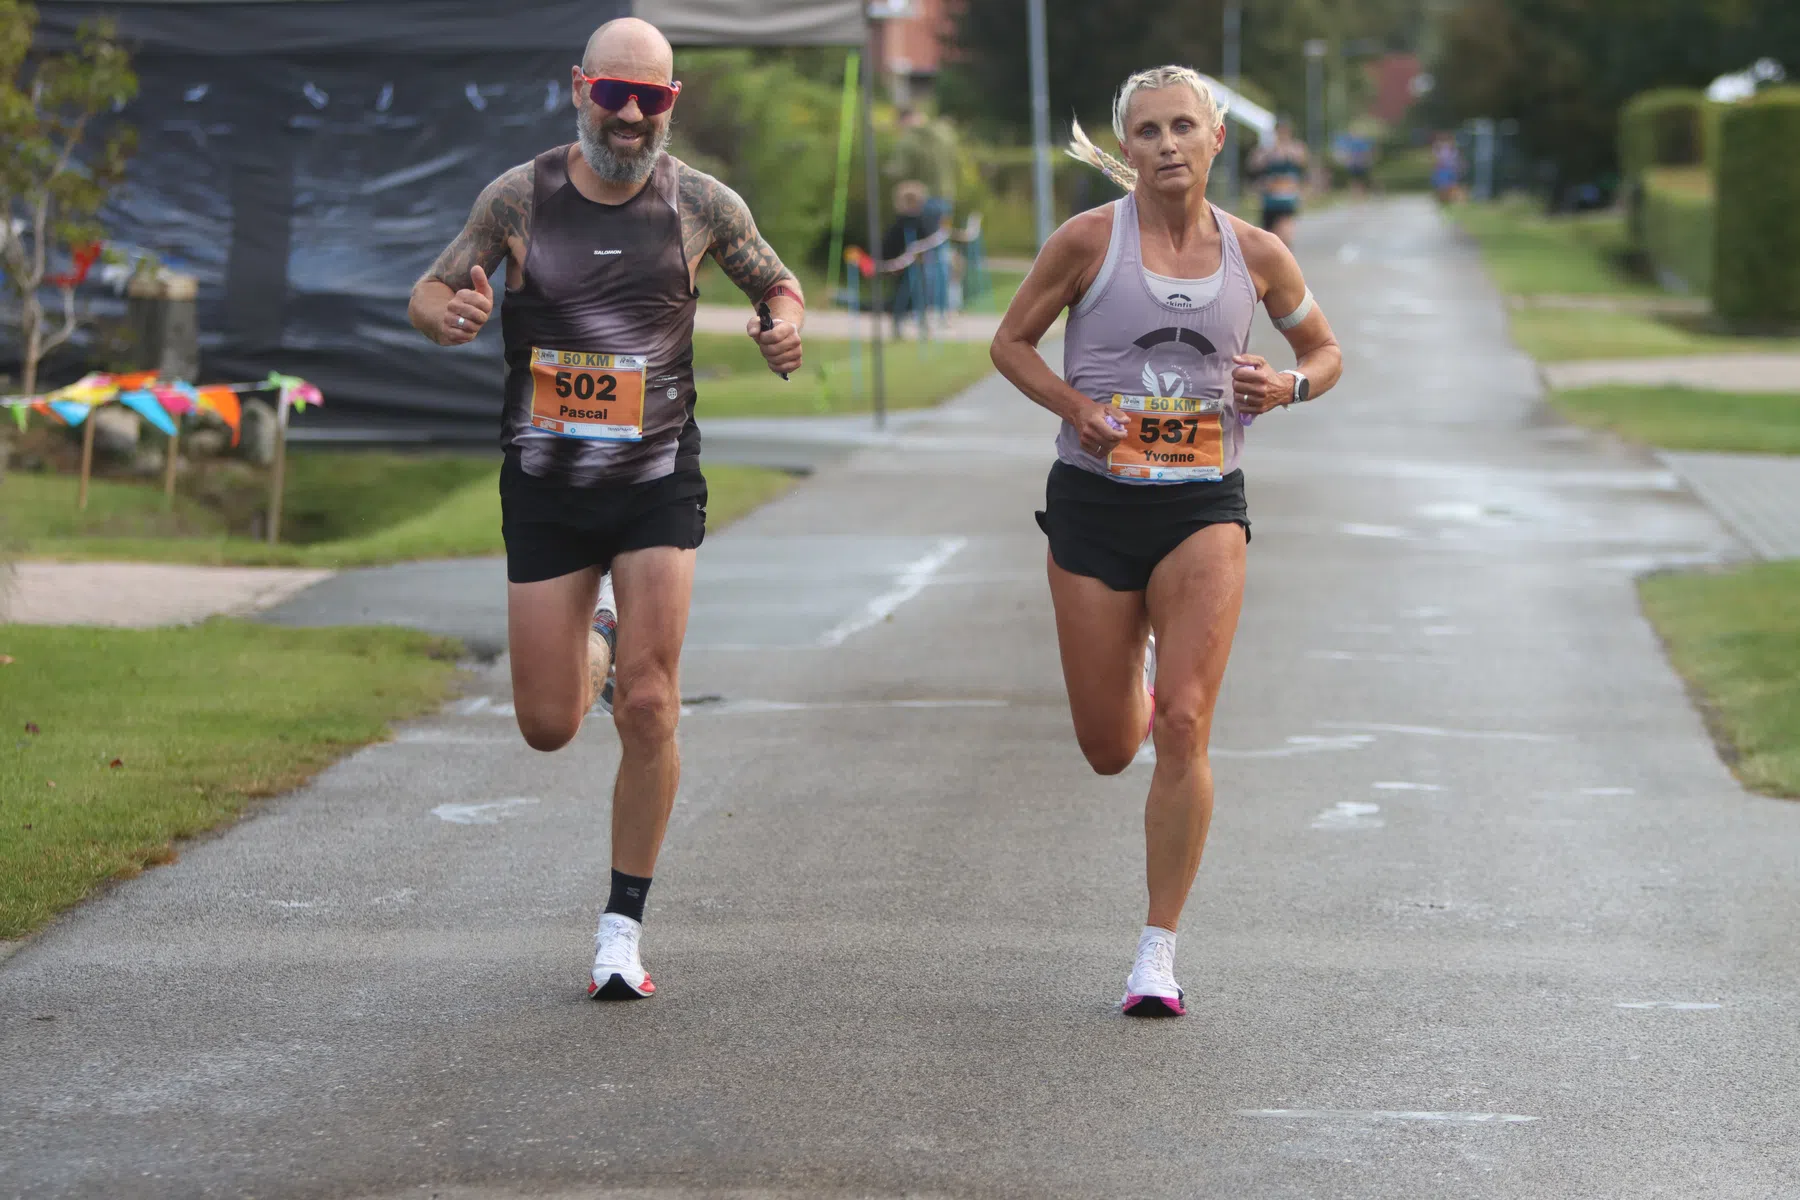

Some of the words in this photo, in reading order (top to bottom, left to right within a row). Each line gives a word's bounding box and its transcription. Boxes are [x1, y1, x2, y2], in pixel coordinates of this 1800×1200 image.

[563, 353, 581, 365] 50
[586, 355, 610, 367] KM
[556, 371, 617, 401] 502
[1150, 398, 1169, 411] 50
[1174, 400, 1197, 411] KM
[560, 405, 608, 420] Pascal
[1139, 417, 1199, 444] 537
[1143, 450, 1195, 463] Yvonne
